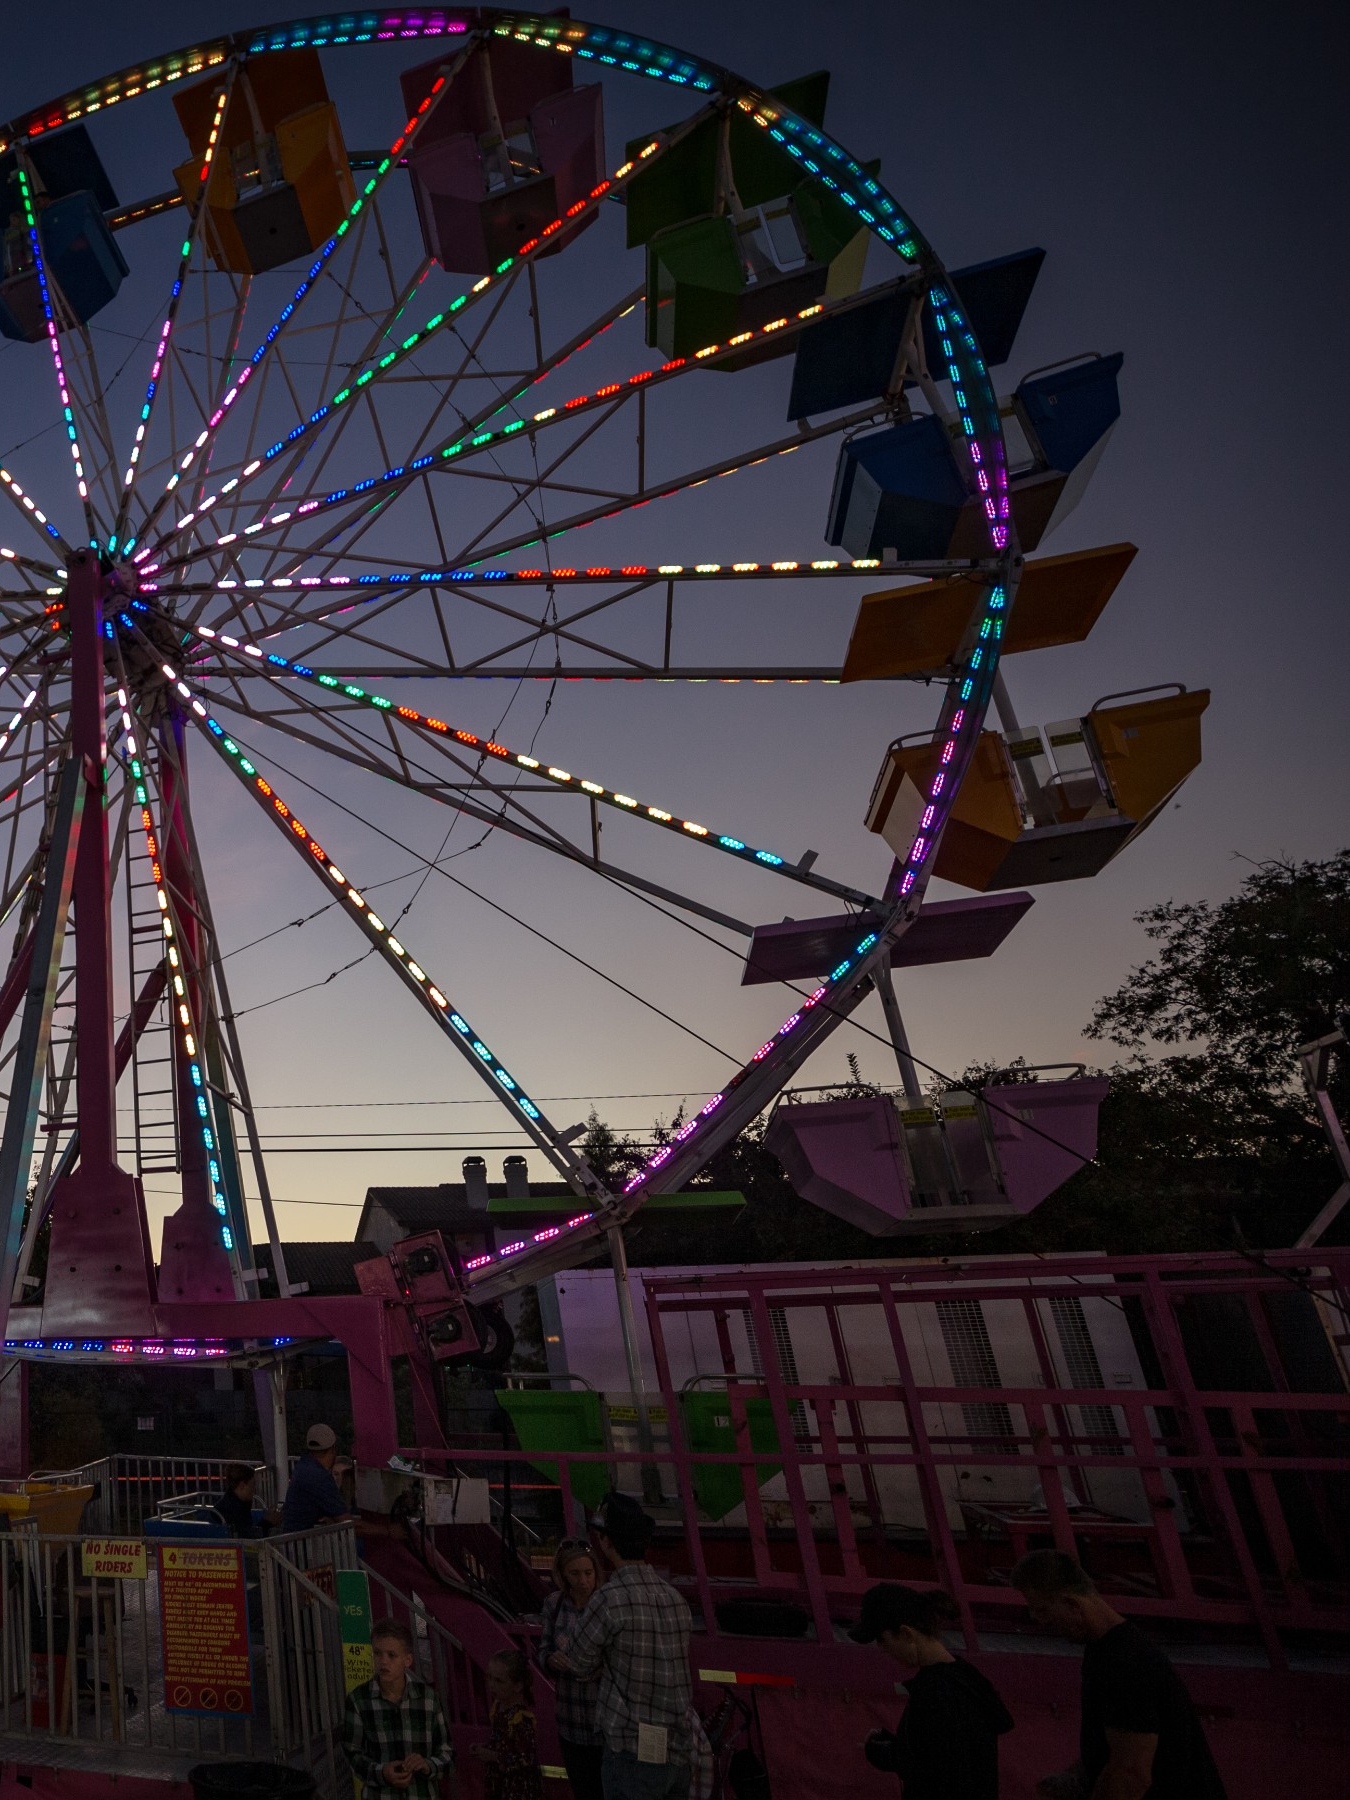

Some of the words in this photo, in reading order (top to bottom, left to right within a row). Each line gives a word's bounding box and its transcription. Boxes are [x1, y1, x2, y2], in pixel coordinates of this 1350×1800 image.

[86, 1543, 101, 1555] NO
[104, 1544, 141, 1557] SINGLE
[182, 1551, 232, 1567] TOKENS
[95, 1561, 133, 1574] RIDERS
[164, 1570, 187, 1578] NOTICE
[198, 1571, 238, 1579] PASSENGERS
[343, 1605, 363, 1617] YES
[349, 1646, 365, 1656] 48"
[346, 1666, 374, 1674] ckete
